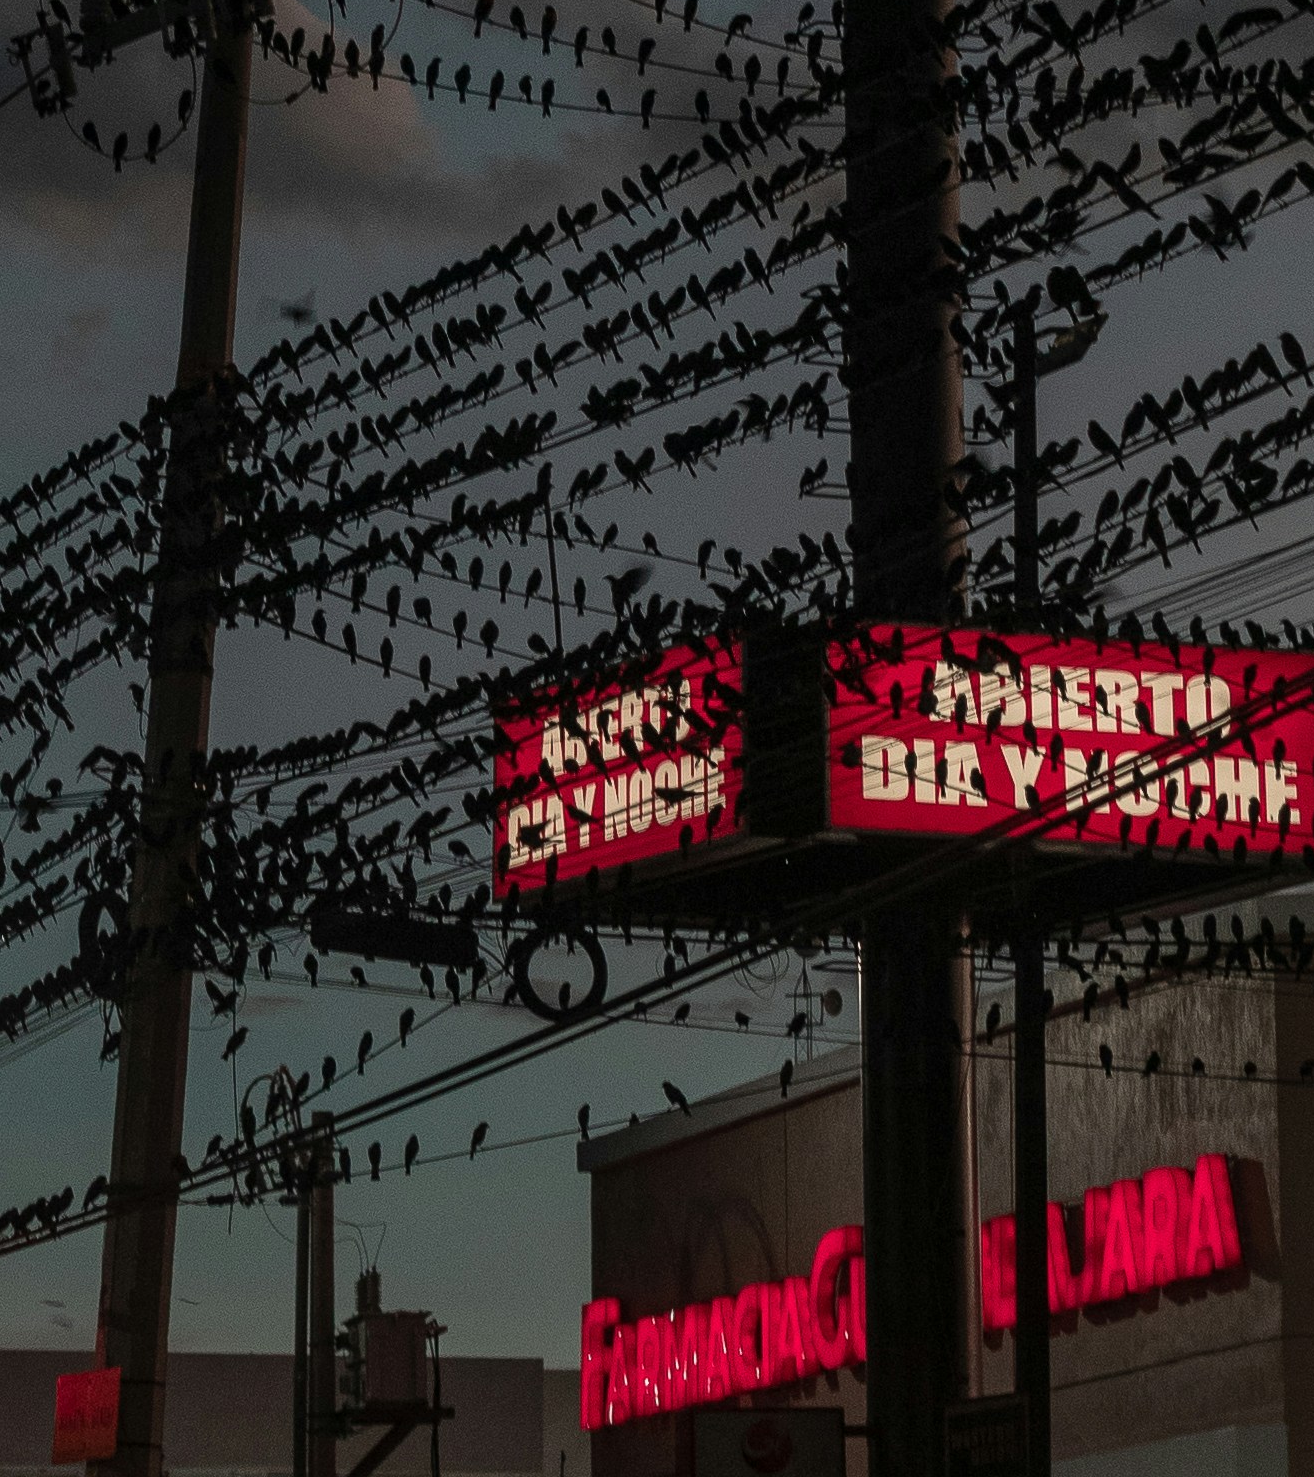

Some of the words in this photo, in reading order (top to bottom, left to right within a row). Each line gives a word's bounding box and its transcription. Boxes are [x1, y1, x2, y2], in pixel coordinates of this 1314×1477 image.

[929, 659, 1232, 738] ABIERTO
[572, 782, 597, 849] Y
[603, 747, 727, 842] NOCHE
[861, 734, 988, 807] DIA
[1000, 743, 1047, 812] Y
[1065, 747, 1301, 825] NOCHE
